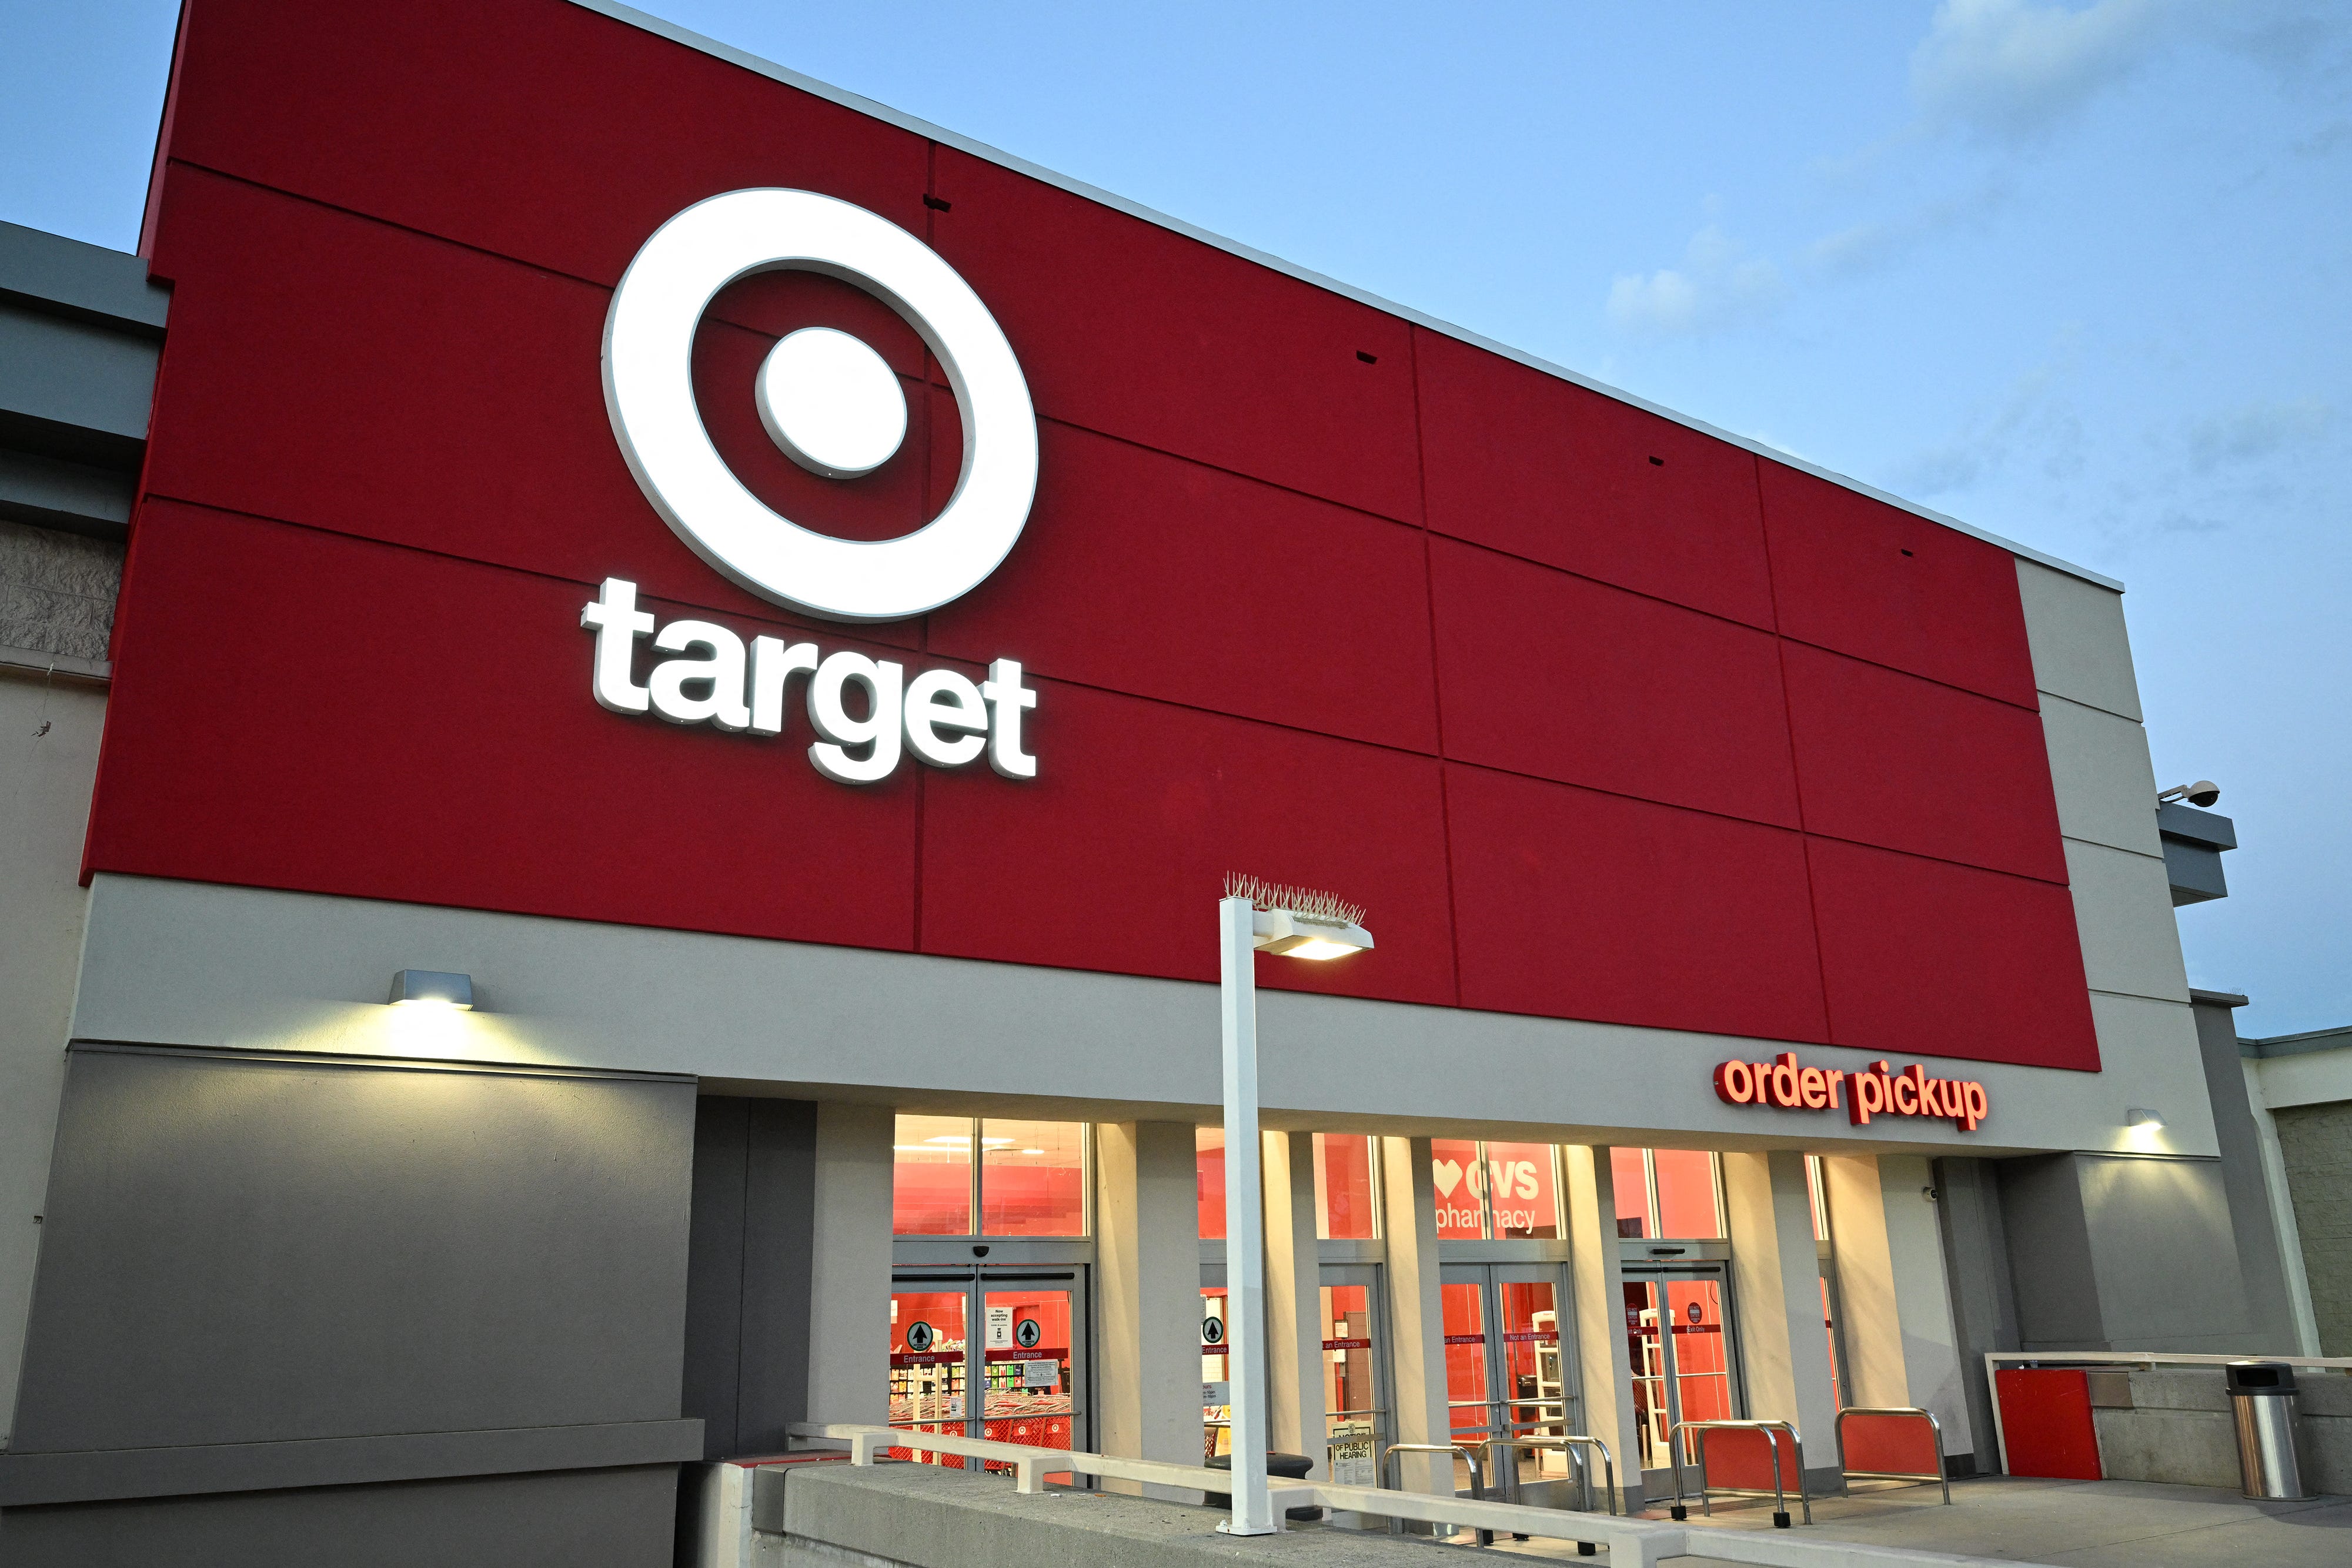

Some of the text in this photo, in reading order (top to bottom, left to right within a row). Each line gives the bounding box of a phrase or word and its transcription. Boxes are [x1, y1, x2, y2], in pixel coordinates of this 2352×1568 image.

[581, 577, 1036, 784] target
[1714, 1052, 1988, 1131] order pickup
[1465, 1160, 1539, 1200] CVS
[904, 1355, 935, 1363] Entrance
[1339, 1450, 1367, 1460] HEARING
[1344, 1442, 1369, 1452] PUBLIC
